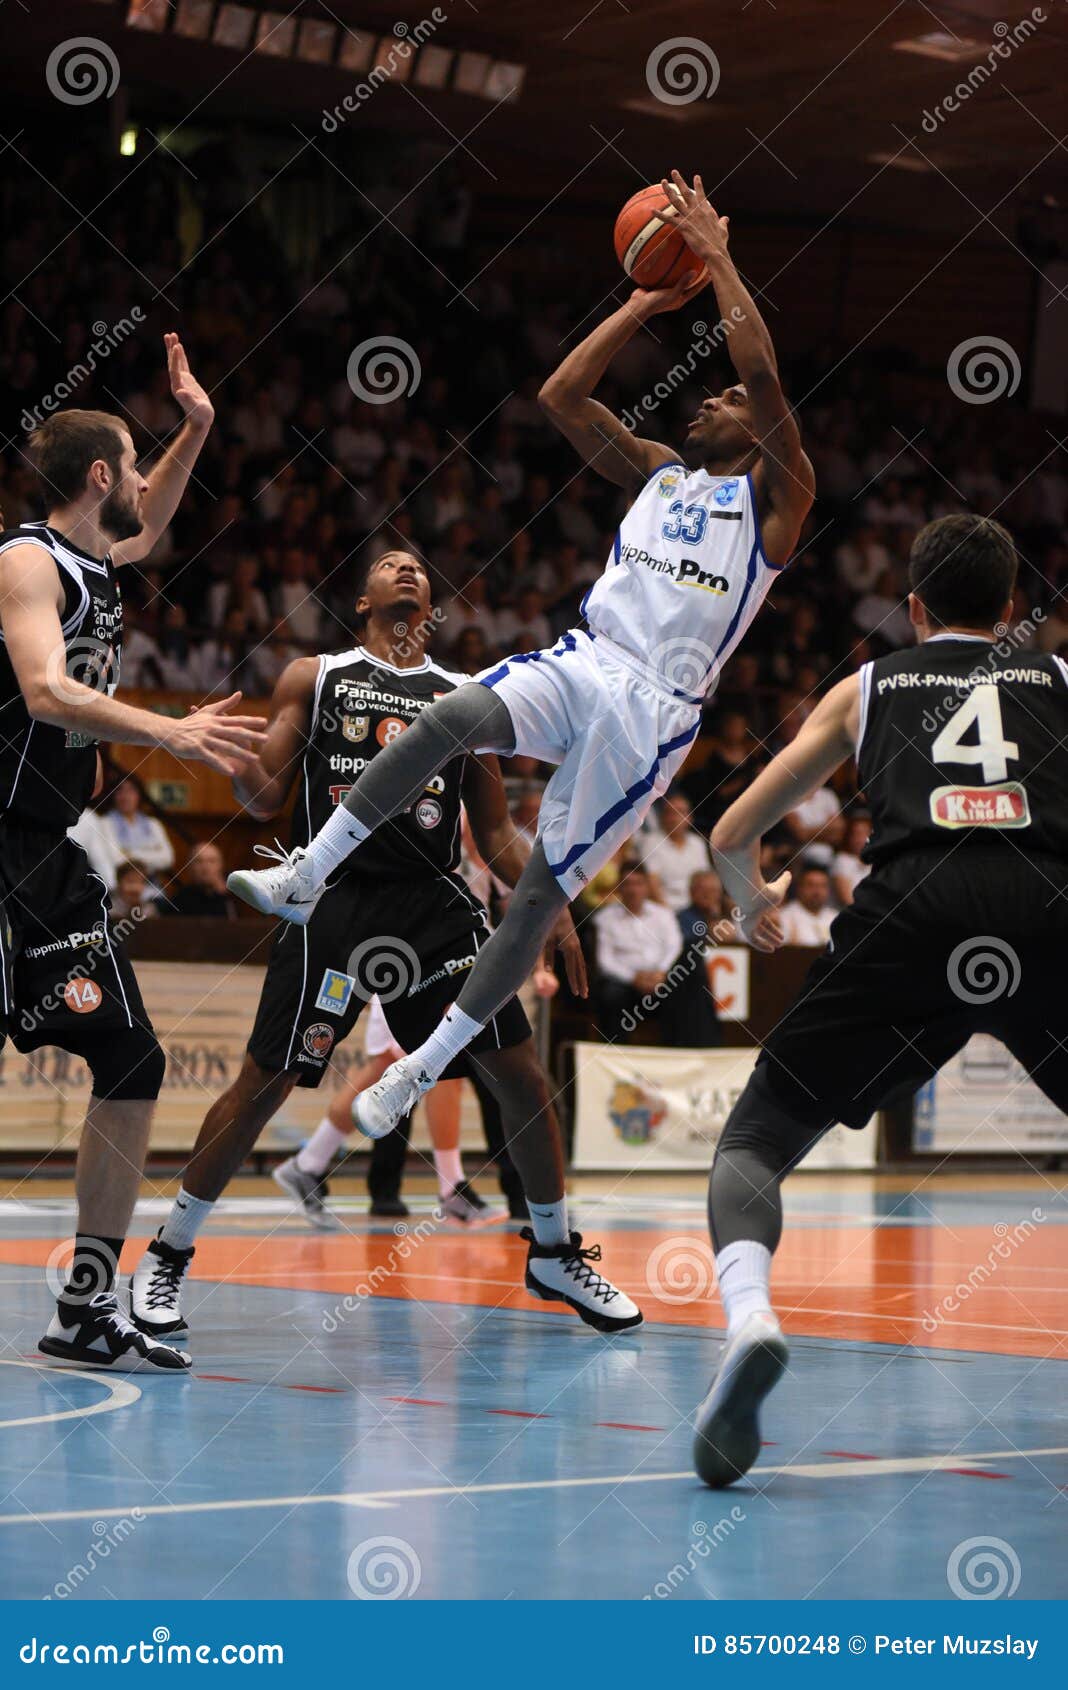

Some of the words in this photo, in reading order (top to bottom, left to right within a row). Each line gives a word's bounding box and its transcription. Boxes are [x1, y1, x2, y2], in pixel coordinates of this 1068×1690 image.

[662, 500, 709, 546] 33
[877, 668, 1053, 695] PVSK-PANNONPOWER
[367, 702, 400, 715] VEOLIA
[931, 684, 1020, 784] 4
[66, 982, 99, 1009] 14
